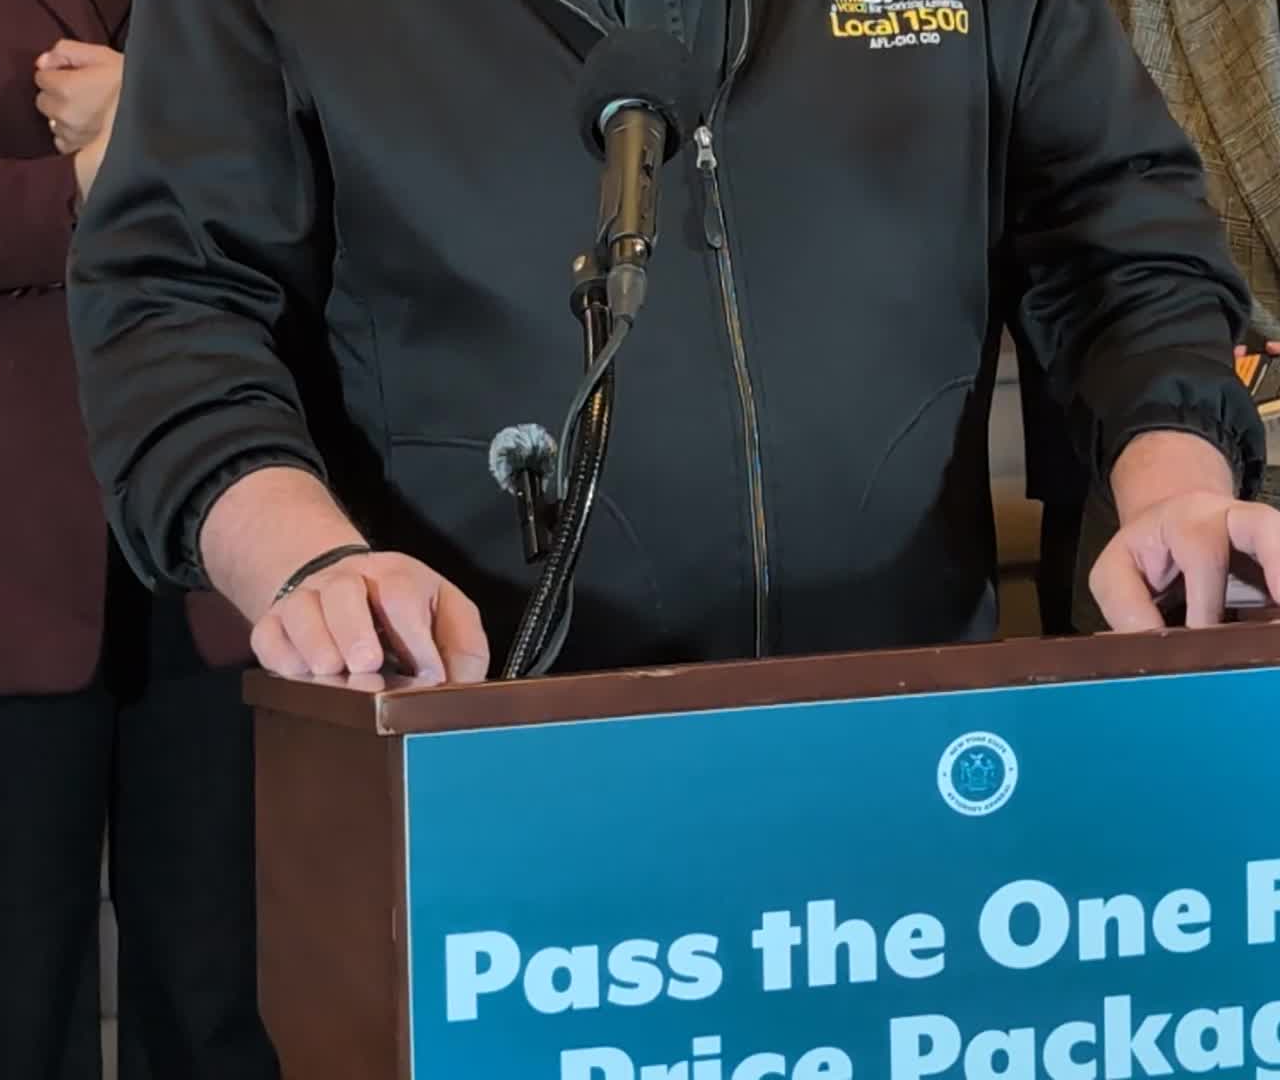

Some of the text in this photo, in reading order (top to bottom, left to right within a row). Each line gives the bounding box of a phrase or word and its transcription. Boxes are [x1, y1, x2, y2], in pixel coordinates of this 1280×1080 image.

[831, 6, 969, 37] Local 1500
[445, 930, 723, 1022] Pass
[751, 899, 946, 991] the
[978, 878, 1211, 970] One
